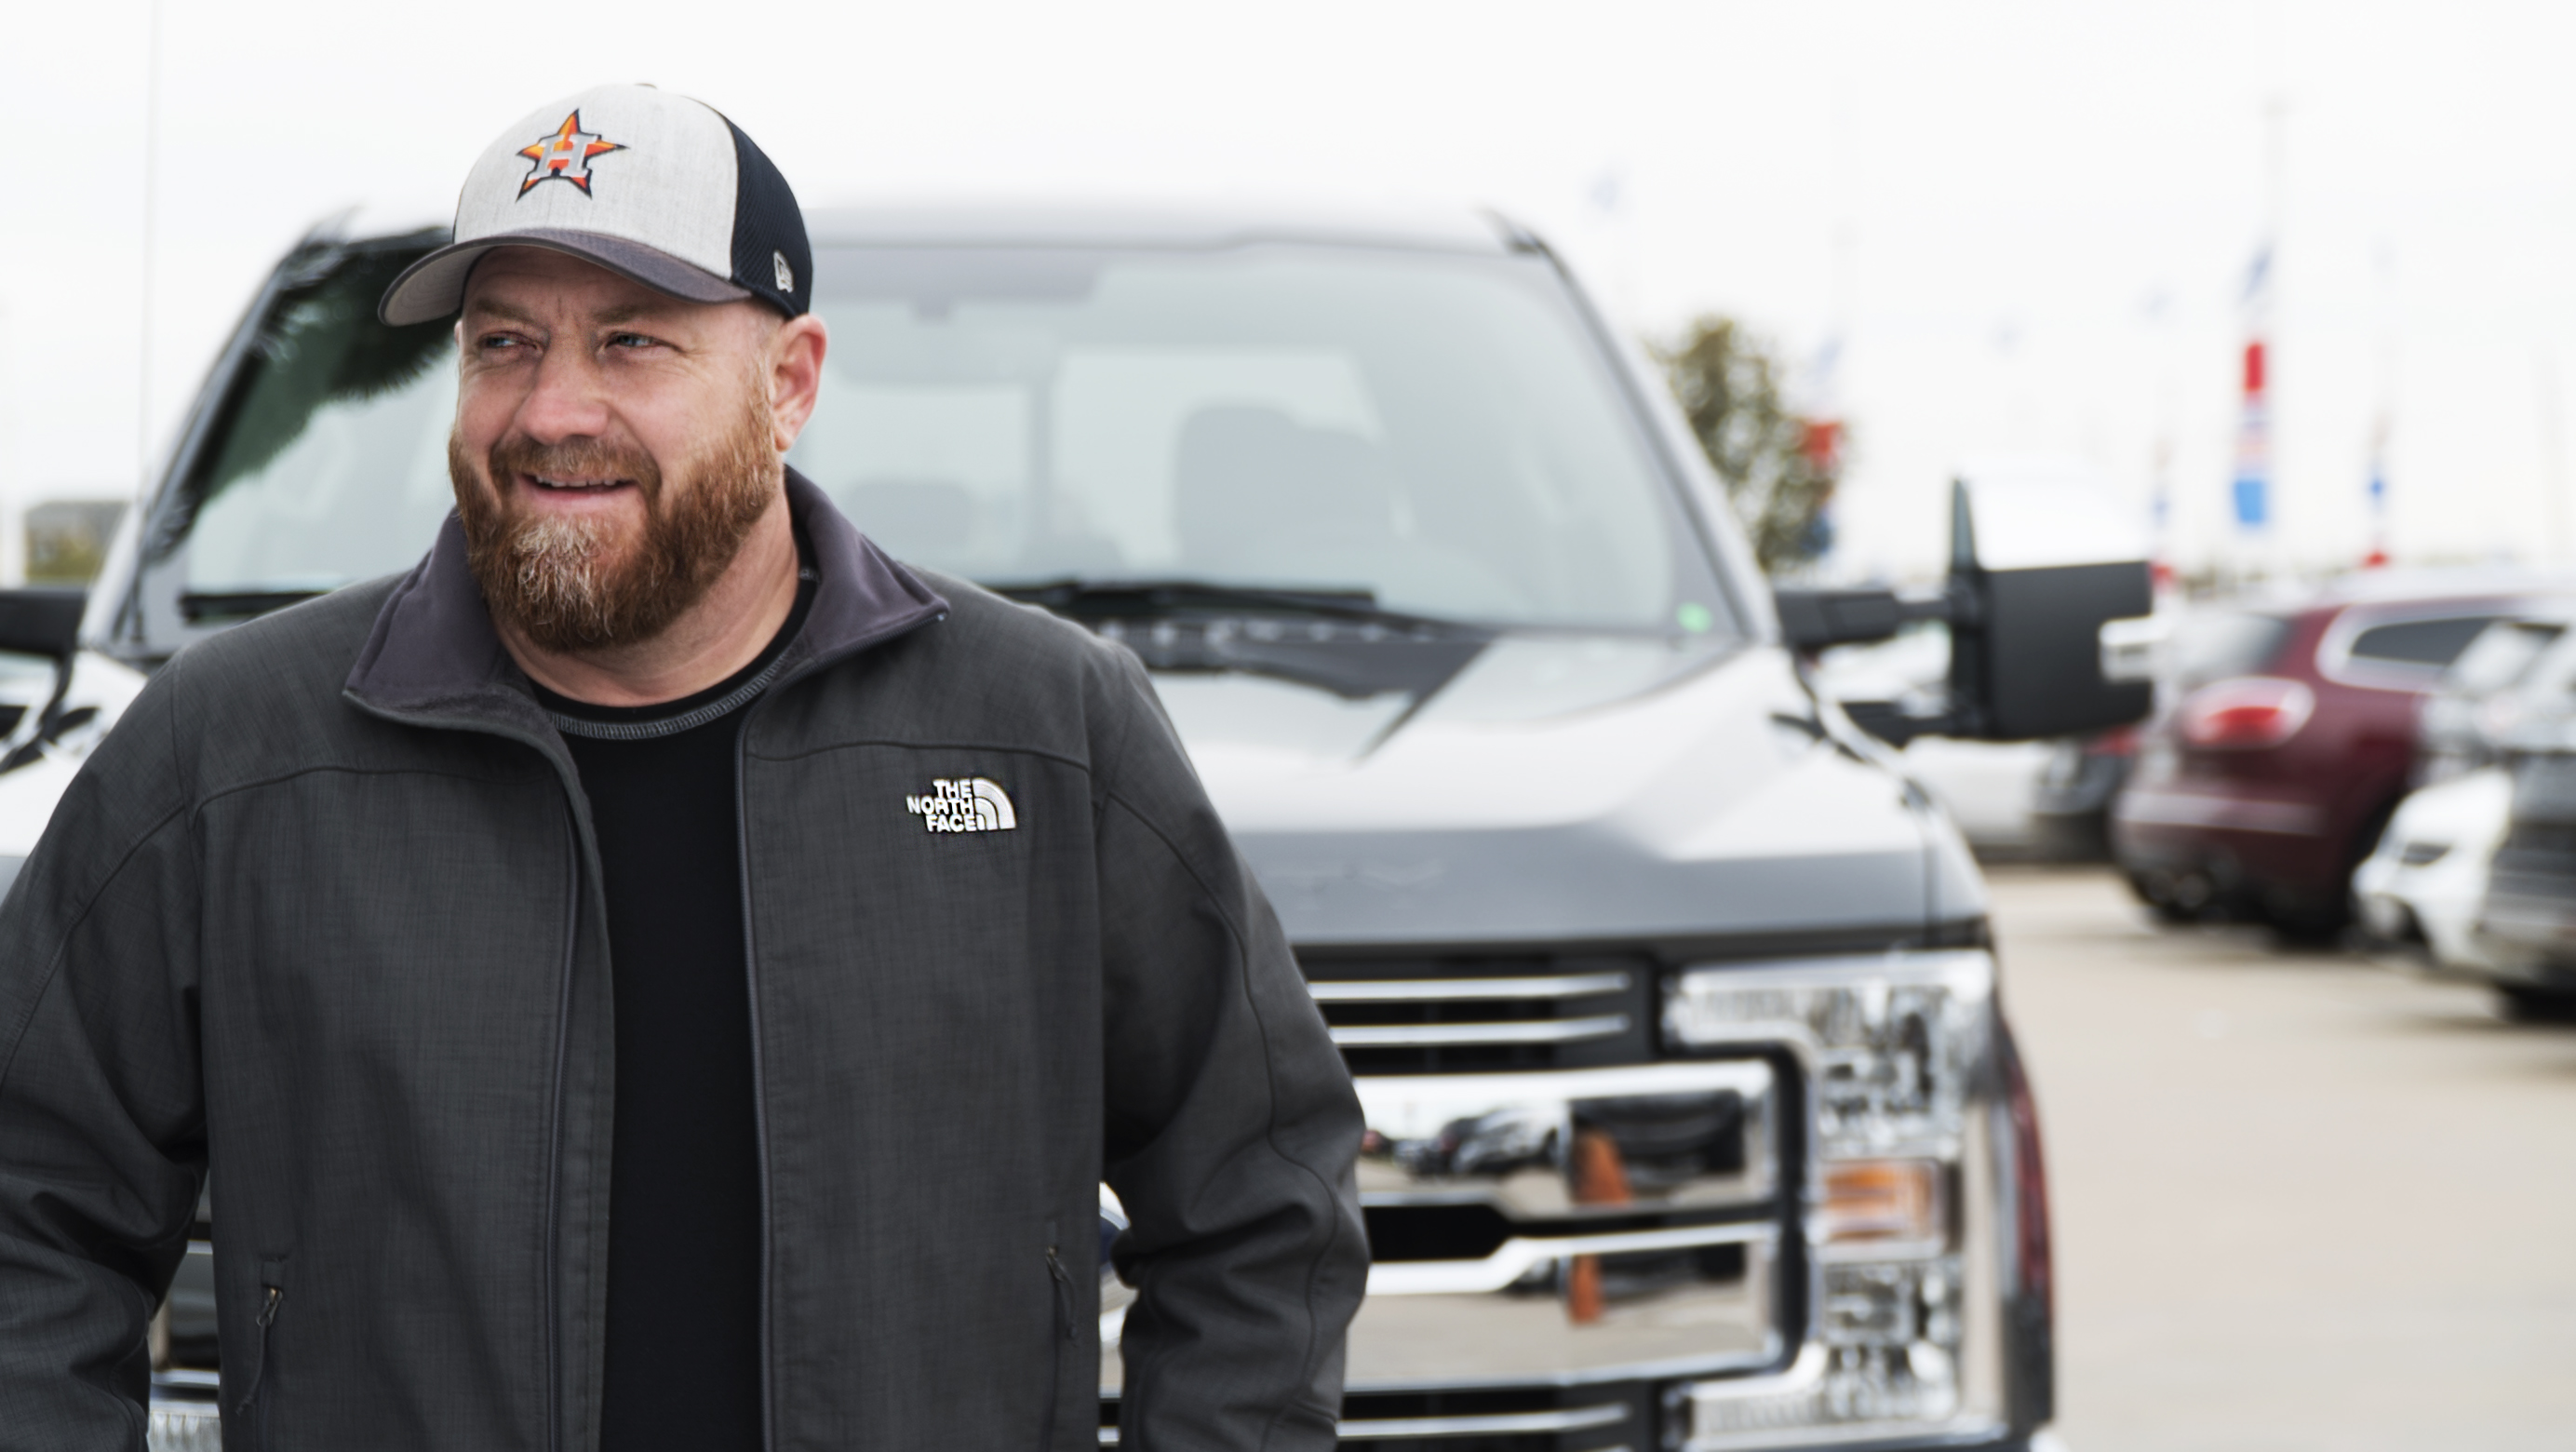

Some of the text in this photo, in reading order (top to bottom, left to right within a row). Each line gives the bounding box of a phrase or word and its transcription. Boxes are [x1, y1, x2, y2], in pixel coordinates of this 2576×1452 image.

[932, 778, 973, 799] THE
[906, 795, 974, 815] NORTH
[926, 813, 976, 832] FACE
